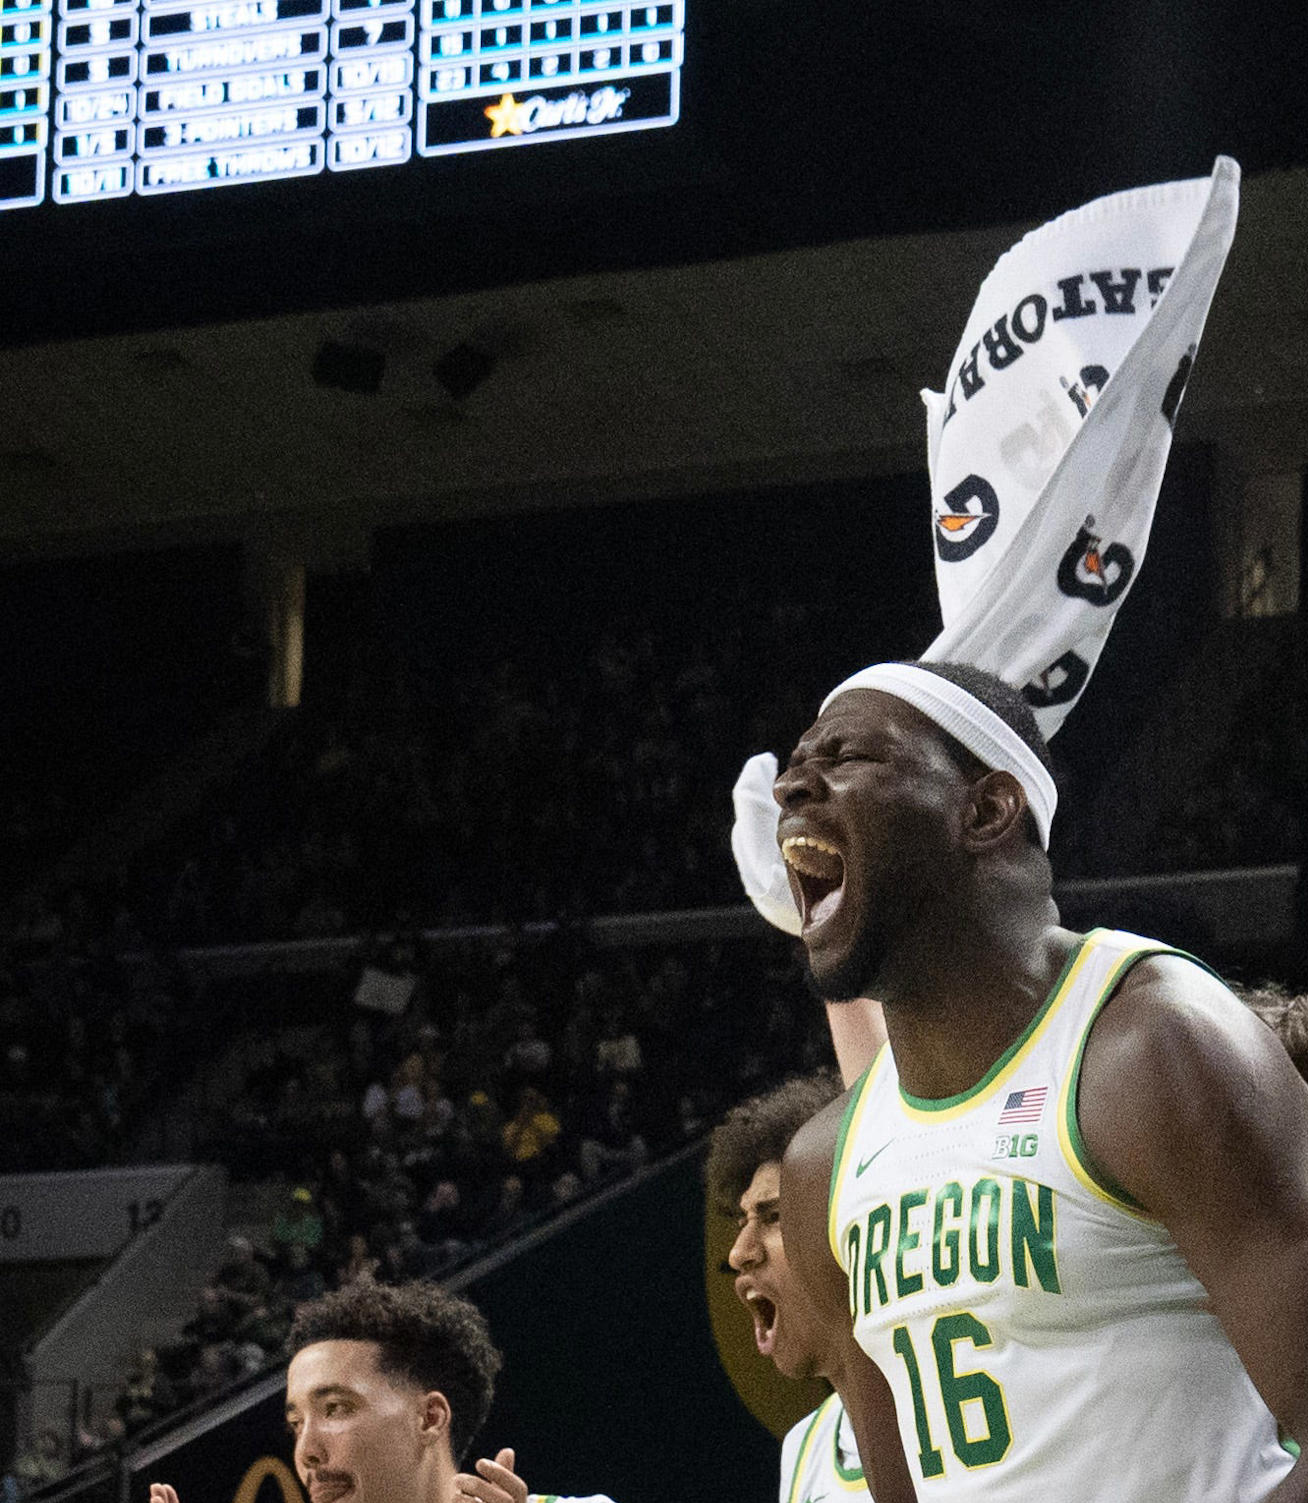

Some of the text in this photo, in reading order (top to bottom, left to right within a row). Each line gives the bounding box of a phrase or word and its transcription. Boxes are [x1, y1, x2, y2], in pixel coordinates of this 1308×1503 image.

[191, 0, 278, 31] STEALS
[847, 1177, 1063, 1324] OREGON
[892, 1310, 1014, 1482] 16
